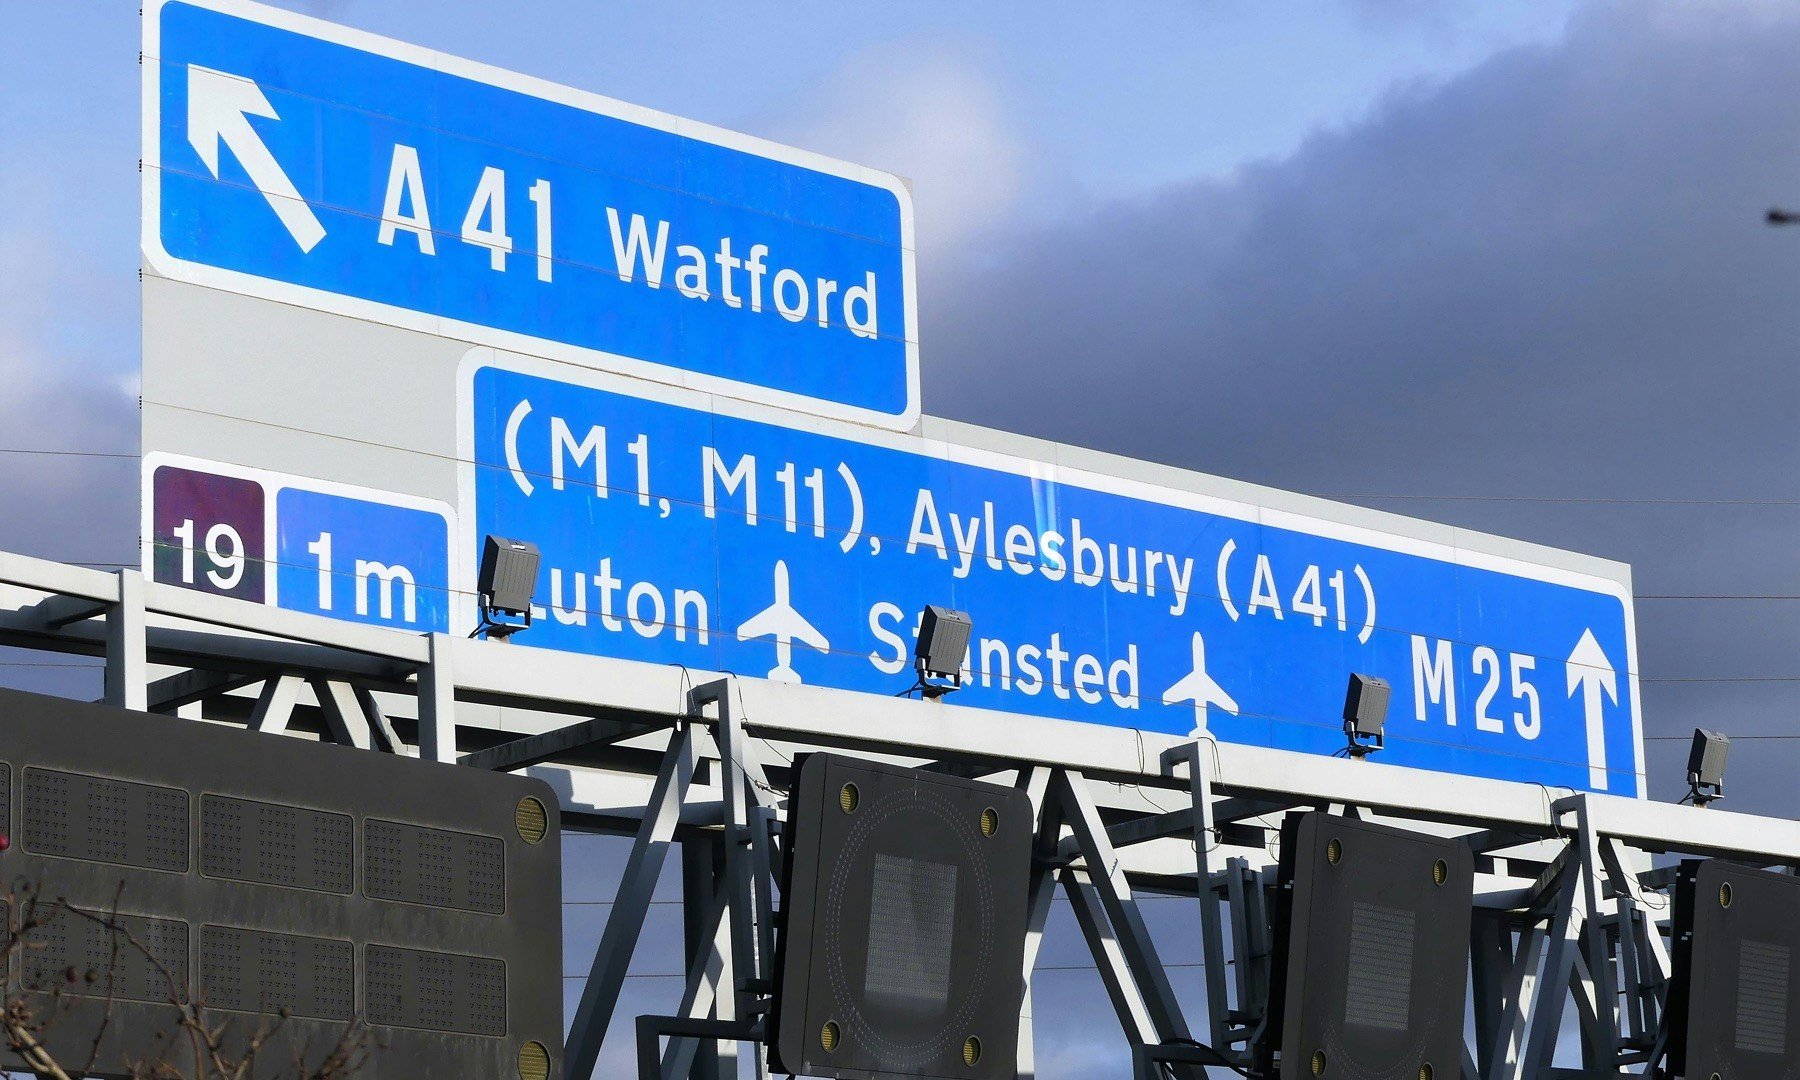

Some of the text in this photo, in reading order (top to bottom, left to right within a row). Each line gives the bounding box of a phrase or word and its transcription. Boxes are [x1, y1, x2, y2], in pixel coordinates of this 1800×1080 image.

[606, 207, 879, 341] Watford
[173, 518, 246, 590] 19
[516, 556, 710, 647] uton
[905, 487, 1195, 617] Aylesbury
